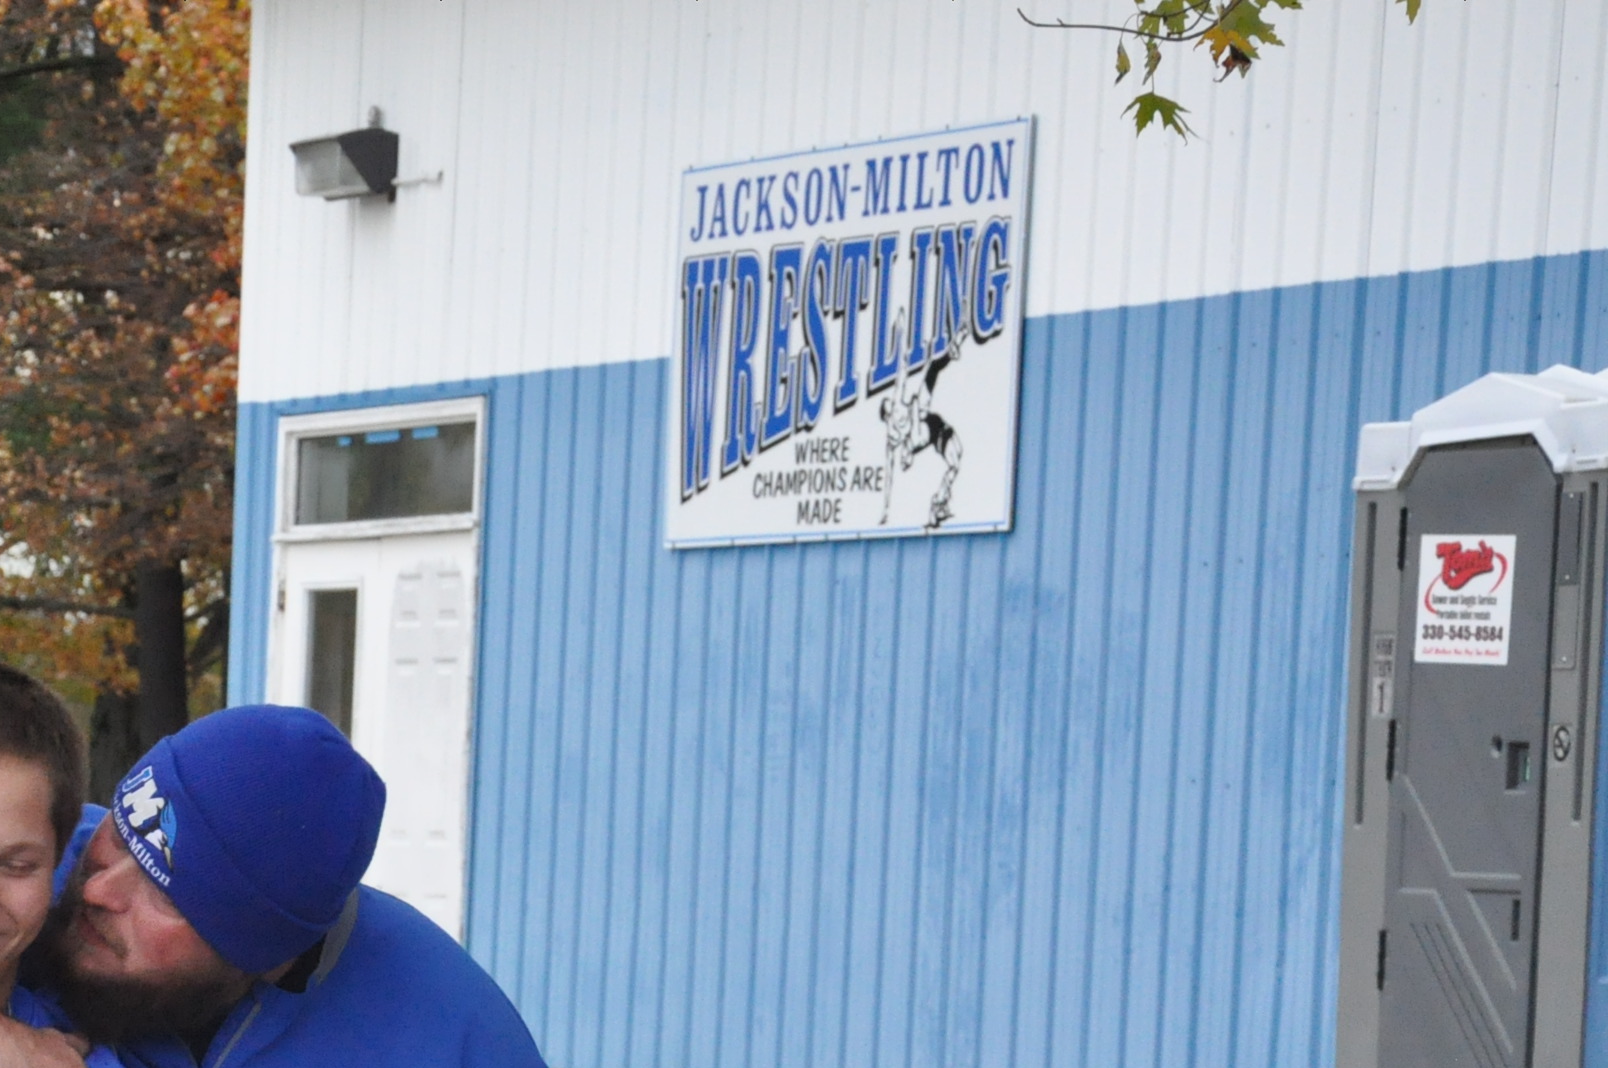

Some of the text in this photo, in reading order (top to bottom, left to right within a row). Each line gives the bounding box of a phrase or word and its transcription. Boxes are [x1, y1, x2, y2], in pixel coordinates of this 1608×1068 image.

[690, 139, 1015, 242] JACKSON-MILTON
[680, 215, 1012, 504] WRESTLING
[752, 465, 883, 499] CHAMPIONS ARE
[794, 437, 851, 463] WHERE
[796, 498, 842, 525] MADE
[112, 788, 171, 887] kson-Milton
